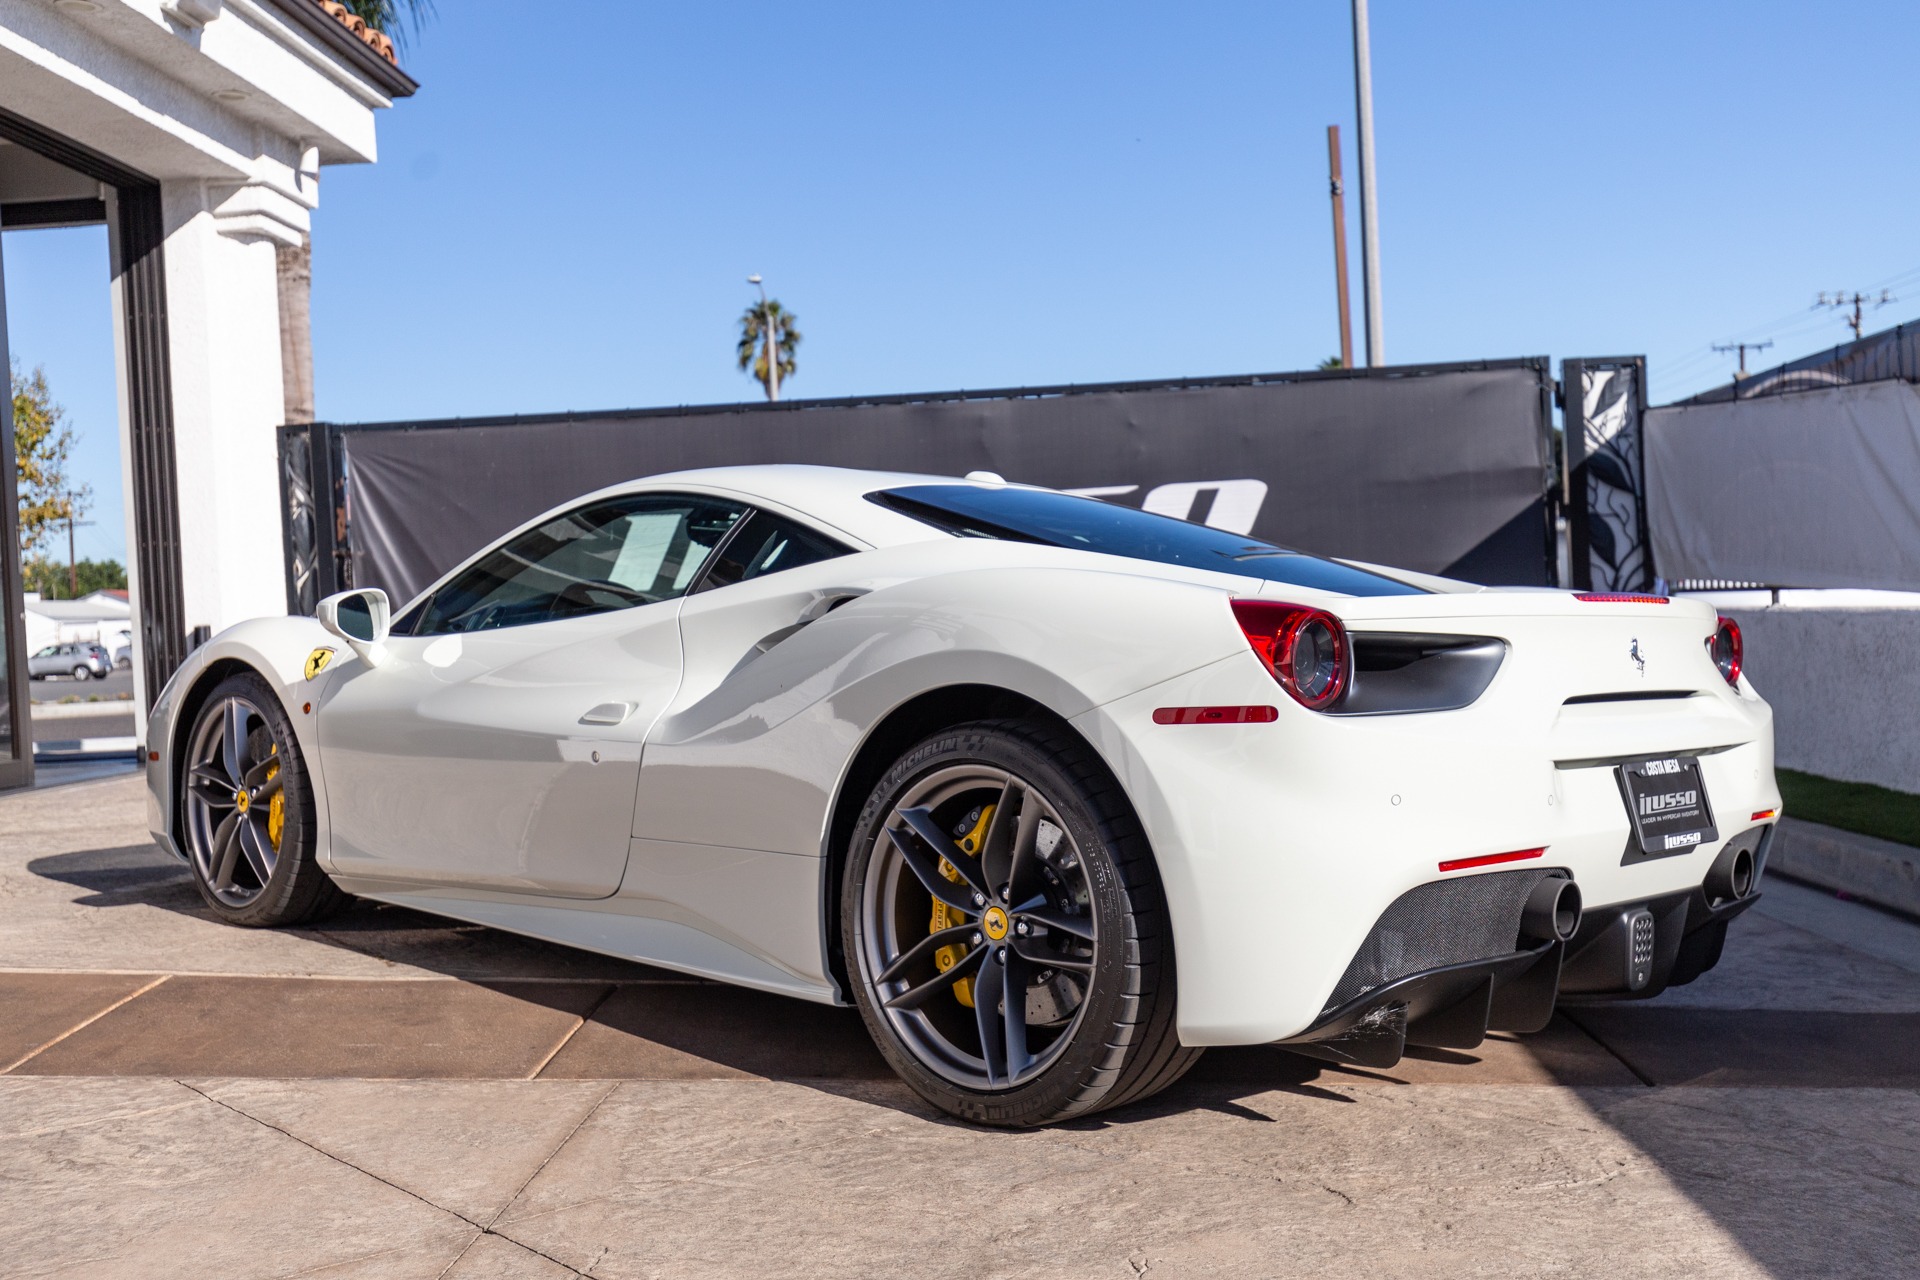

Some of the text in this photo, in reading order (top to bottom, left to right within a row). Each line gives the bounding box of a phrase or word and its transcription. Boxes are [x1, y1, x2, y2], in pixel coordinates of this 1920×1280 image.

[892, 739, 957, 783] MICHELIN
[1646, 759, 1681, 776] COSTA MESA
[1641, 816, 1656, 824] LEADER
[1662, 812, 1681, 821] HYPERCAR
